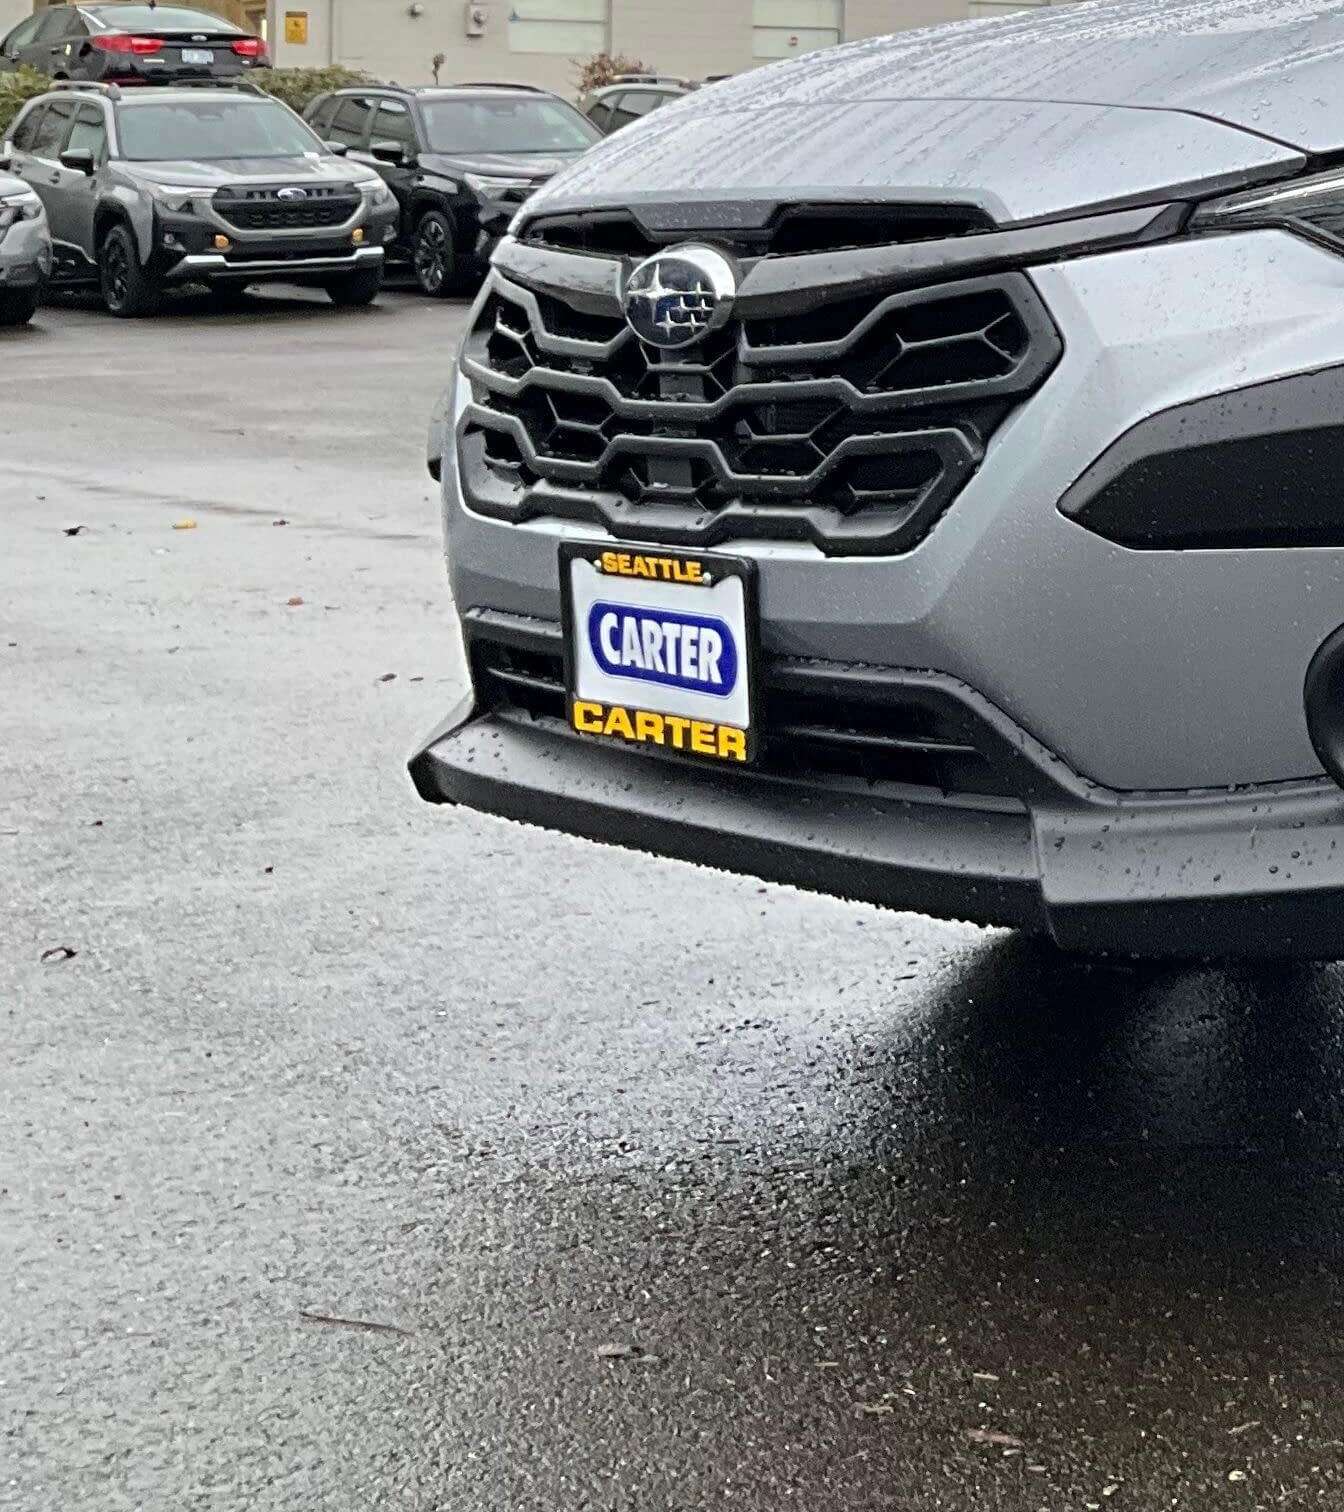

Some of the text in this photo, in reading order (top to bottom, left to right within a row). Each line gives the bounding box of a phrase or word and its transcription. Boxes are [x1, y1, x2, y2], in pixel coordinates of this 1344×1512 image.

[602, 551, 704, 583] SEATTLE
[600, 612, 723, 684] CARTER
[573, 700, 747, 761] CARTER
